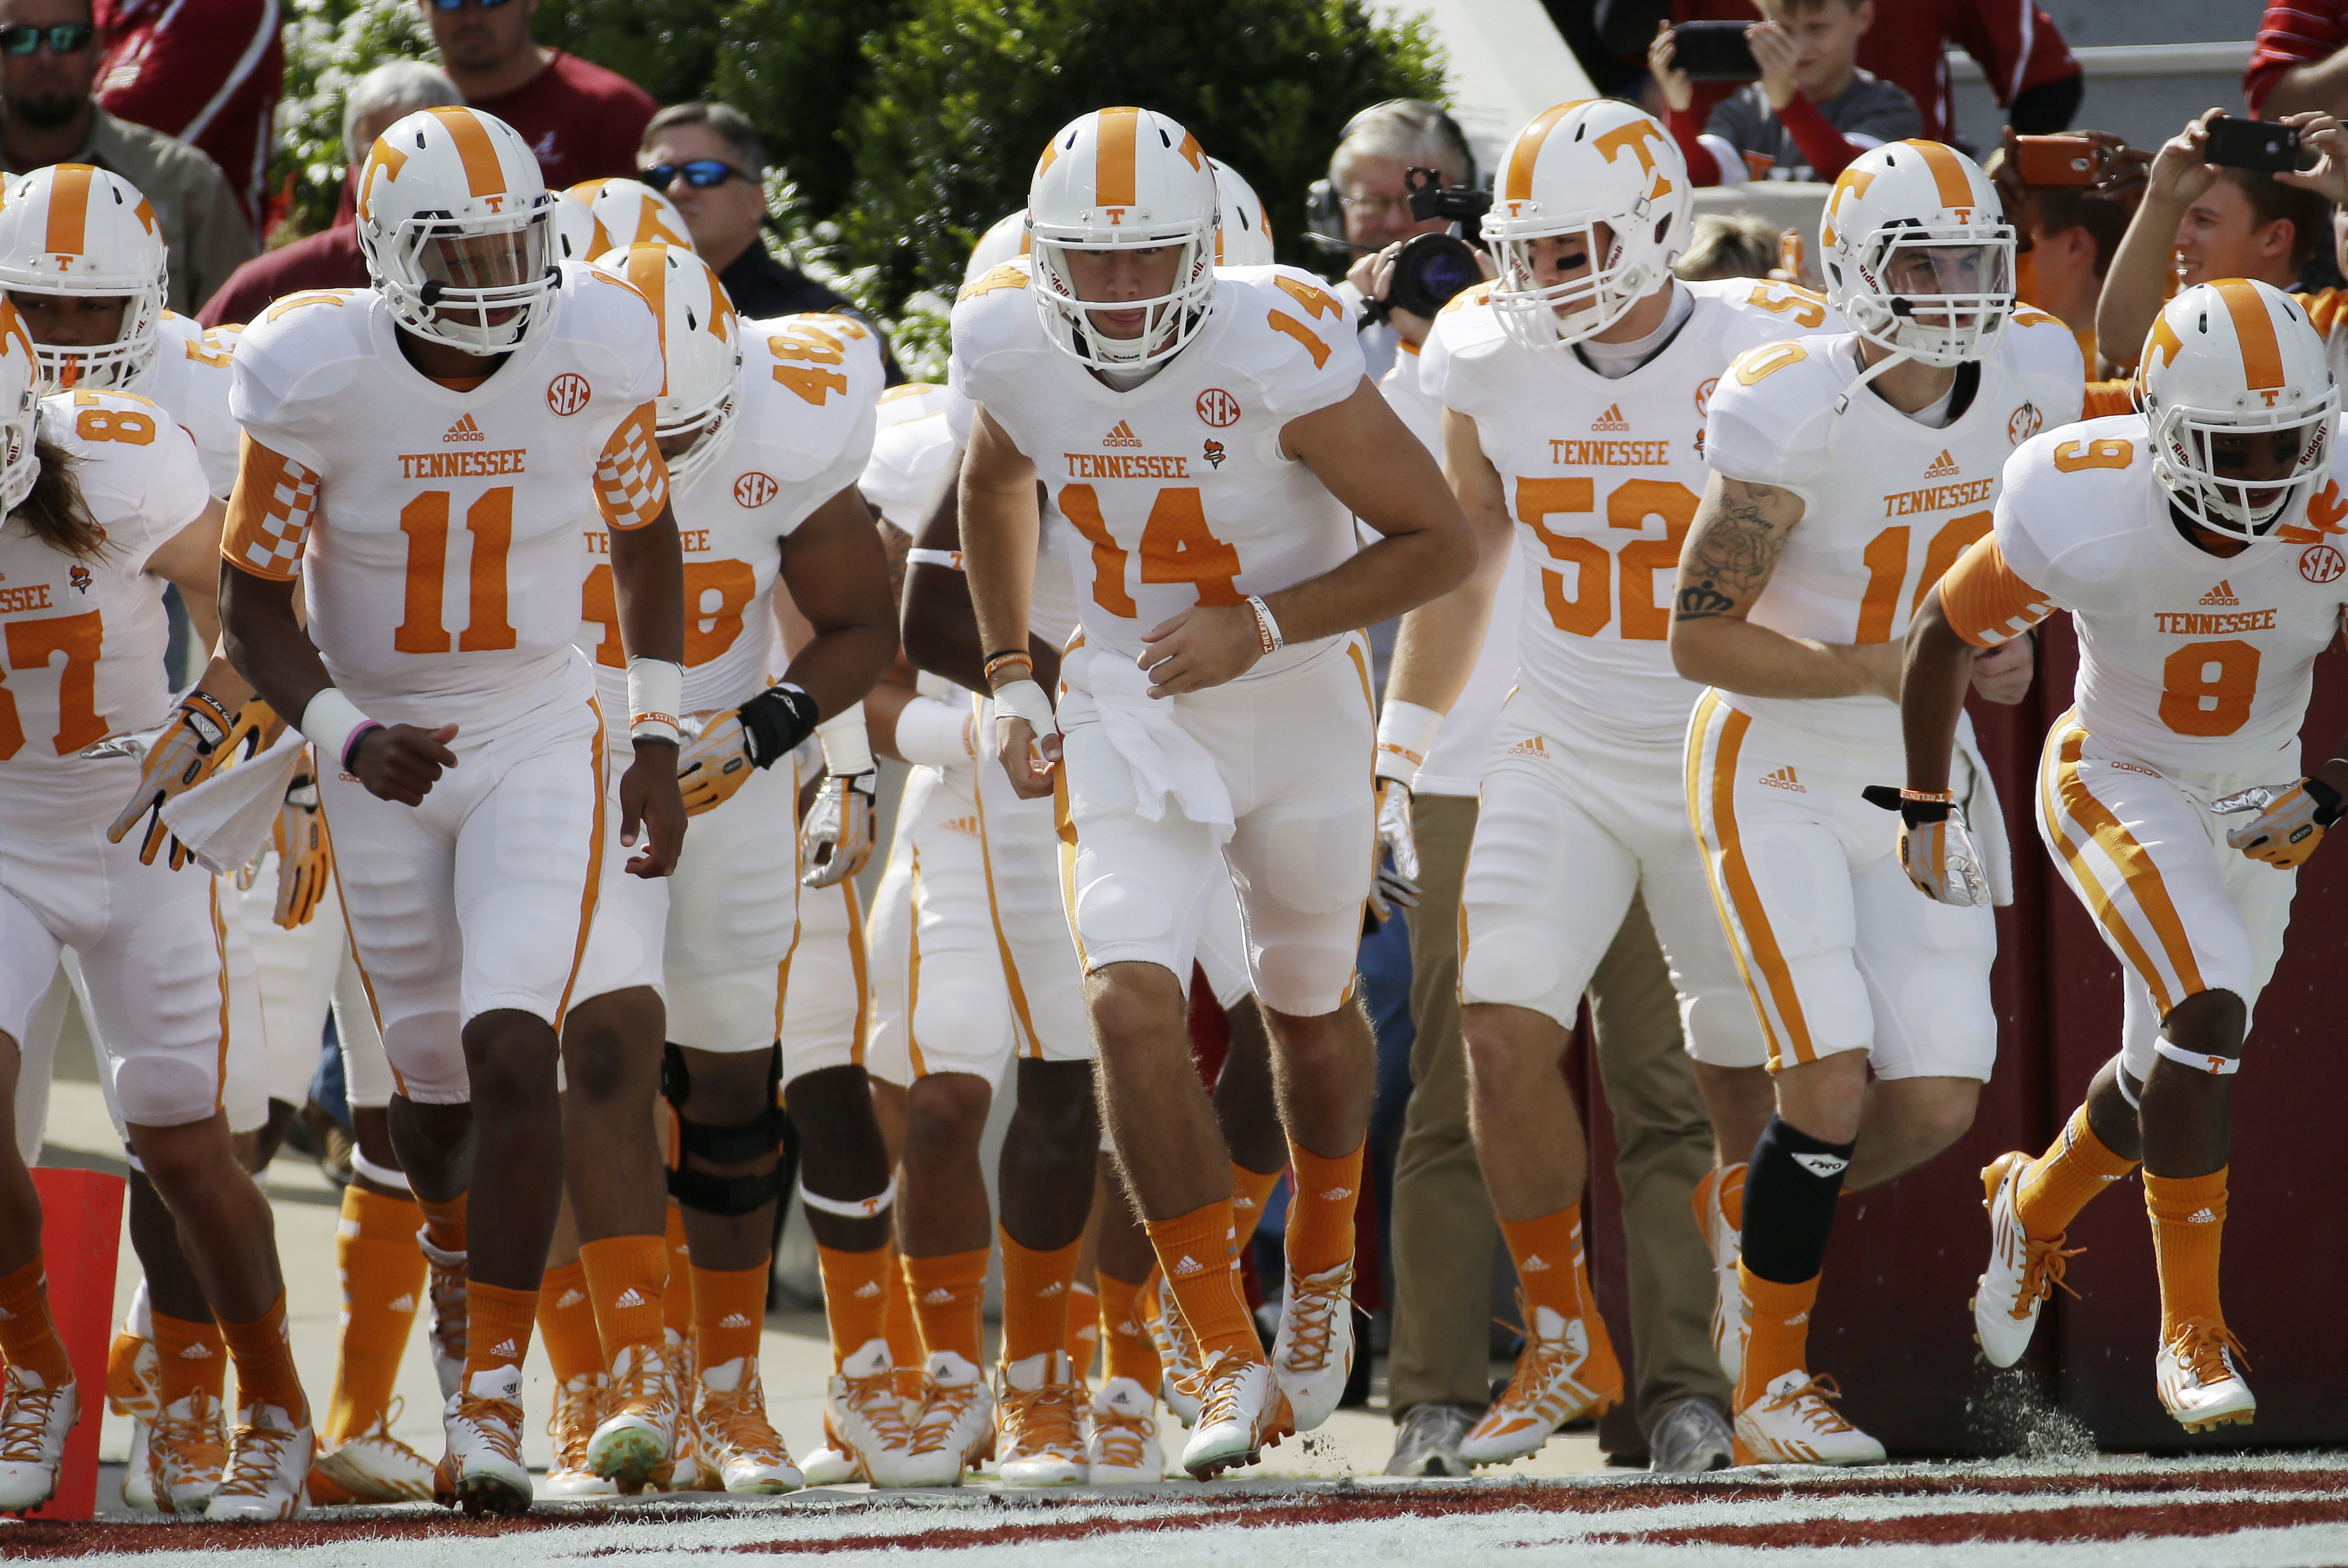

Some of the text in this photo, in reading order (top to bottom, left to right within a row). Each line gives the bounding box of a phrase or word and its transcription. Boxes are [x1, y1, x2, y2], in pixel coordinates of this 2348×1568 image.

[485, 196, 503, 213] T
[1508, 202, 1521, 217] T
[1107, 209, 1125, 224] T
[1955, 209, 1970, 224] T
[56, 256, 74, 271] T
[1267, 274, 1342, 371] 14
[549, 374, 589, 415] SEC
[2260, 390, 2279, 407] T
[1198, 389, 1239, 426] SEC
[1591, 421, 1629, 431] adidas
[443, 432, 484, 442] adidas
[1103, 437, 1142, 447] adidas
[2299, 425, 2327, 465] Riddell
[1549, 439, 1669, 465] TENNESSEE
[399, 449, 526, 478] TENNESSEE
[1063, 452, 1190, 478] TENNESSEE
[1924, 467, 1960, 479] adidas
[735, 473, 777, 507] SEC
[1884, 478, 1994, 516] TENNESSEE
[1058, 483, 1251, 619] 14
[1516, 475, 1701, 641] 52
[394, 486, 517, 654] 11
[2294, 546, 2344, 582] SEC
[2199, 597, 2239, 605] adidas
[2155, 608, 2278, 634] TENNESSEE
[2158, 639, 2261, 737] 8
[1508, 747, 1551, 759] adidas
[1759, 778, 1807, 793] adidas
[2207, 1056, 2226, 1074] T
[862, 1199, 879, 1215] T
[2188, 1214, 2216, 1223] adidas
[1173, 1263, 1204, 1275] adidas
[615, 1299, 645, 1309] adidas
[490, 1347, 518, 1358] adidas
